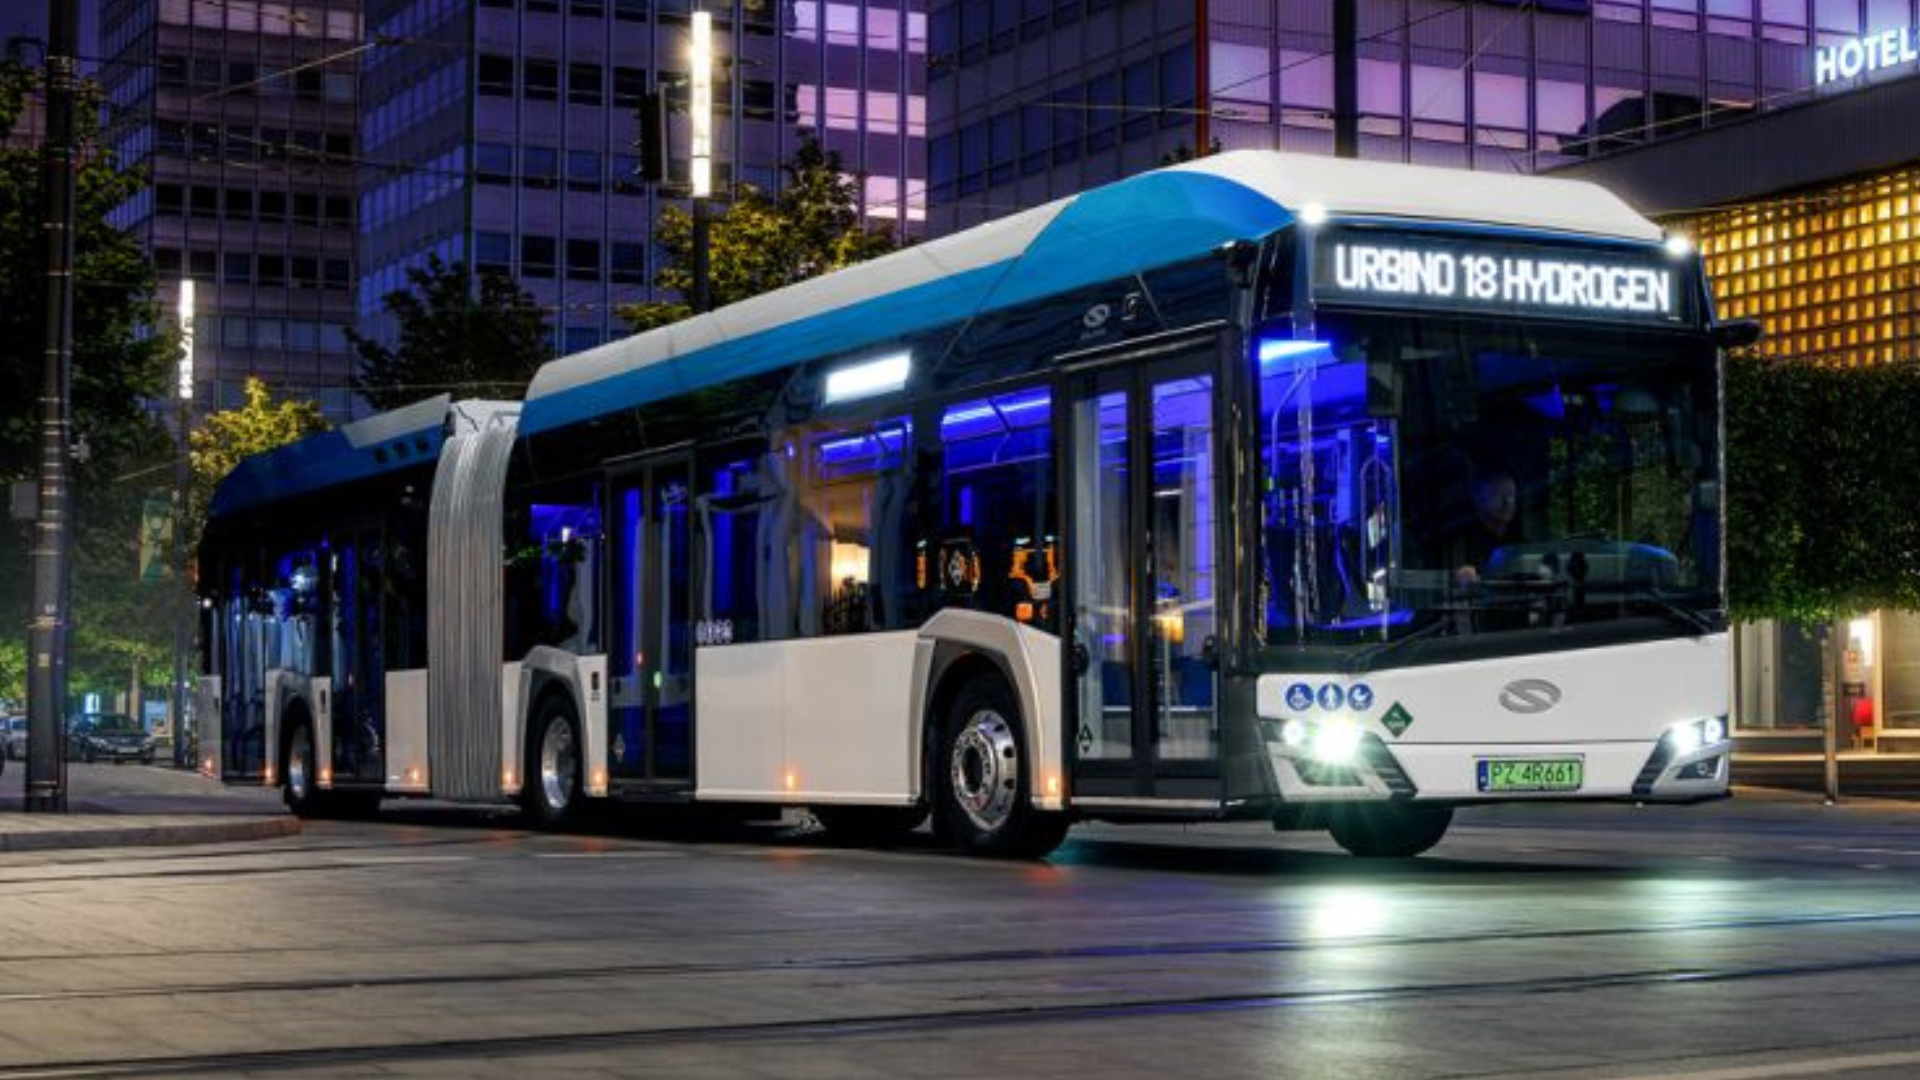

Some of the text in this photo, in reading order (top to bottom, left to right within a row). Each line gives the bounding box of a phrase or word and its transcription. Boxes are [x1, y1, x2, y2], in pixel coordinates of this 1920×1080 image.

[1815, 27, 1917, 86] HOTEL
[1335, 243, 1670, 312] URBINO 18 HYDROGEN
